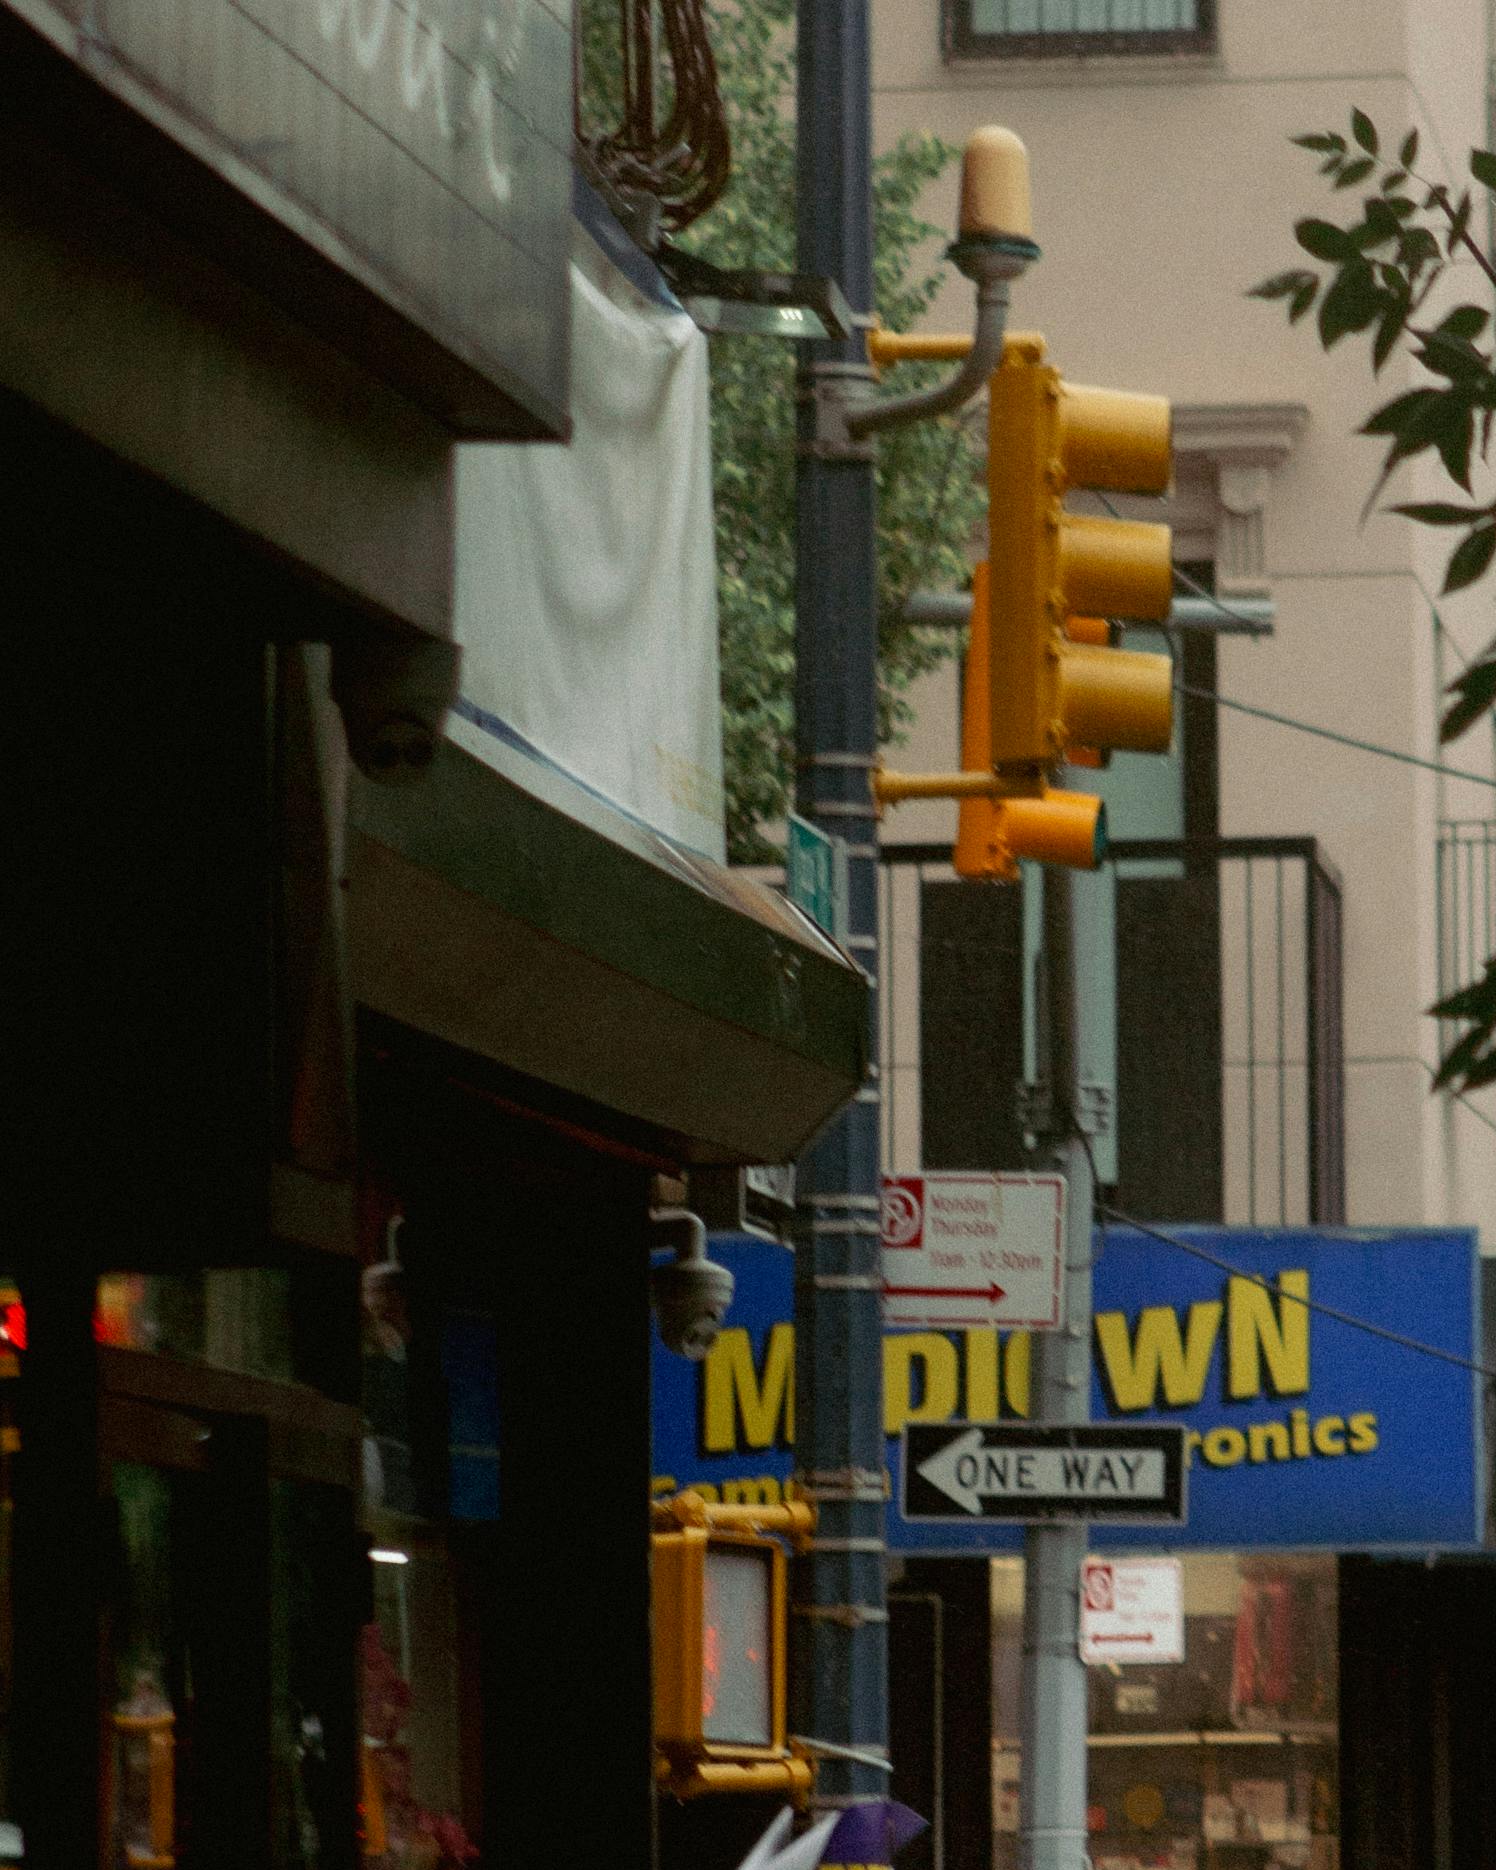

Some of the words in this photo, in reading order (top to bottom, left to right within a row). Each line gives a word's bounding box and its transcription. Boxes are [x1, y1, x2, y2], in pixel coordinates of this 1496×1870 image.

[930, 1194, 990, 1215] Monday
[930, 1217, 999, 1238] Thursday
[1184, 1409, 1379, 1469] ronics
[955, 1454, 1036, 1490] ONE
[1062, 1454, 1144, 1491] WAY
